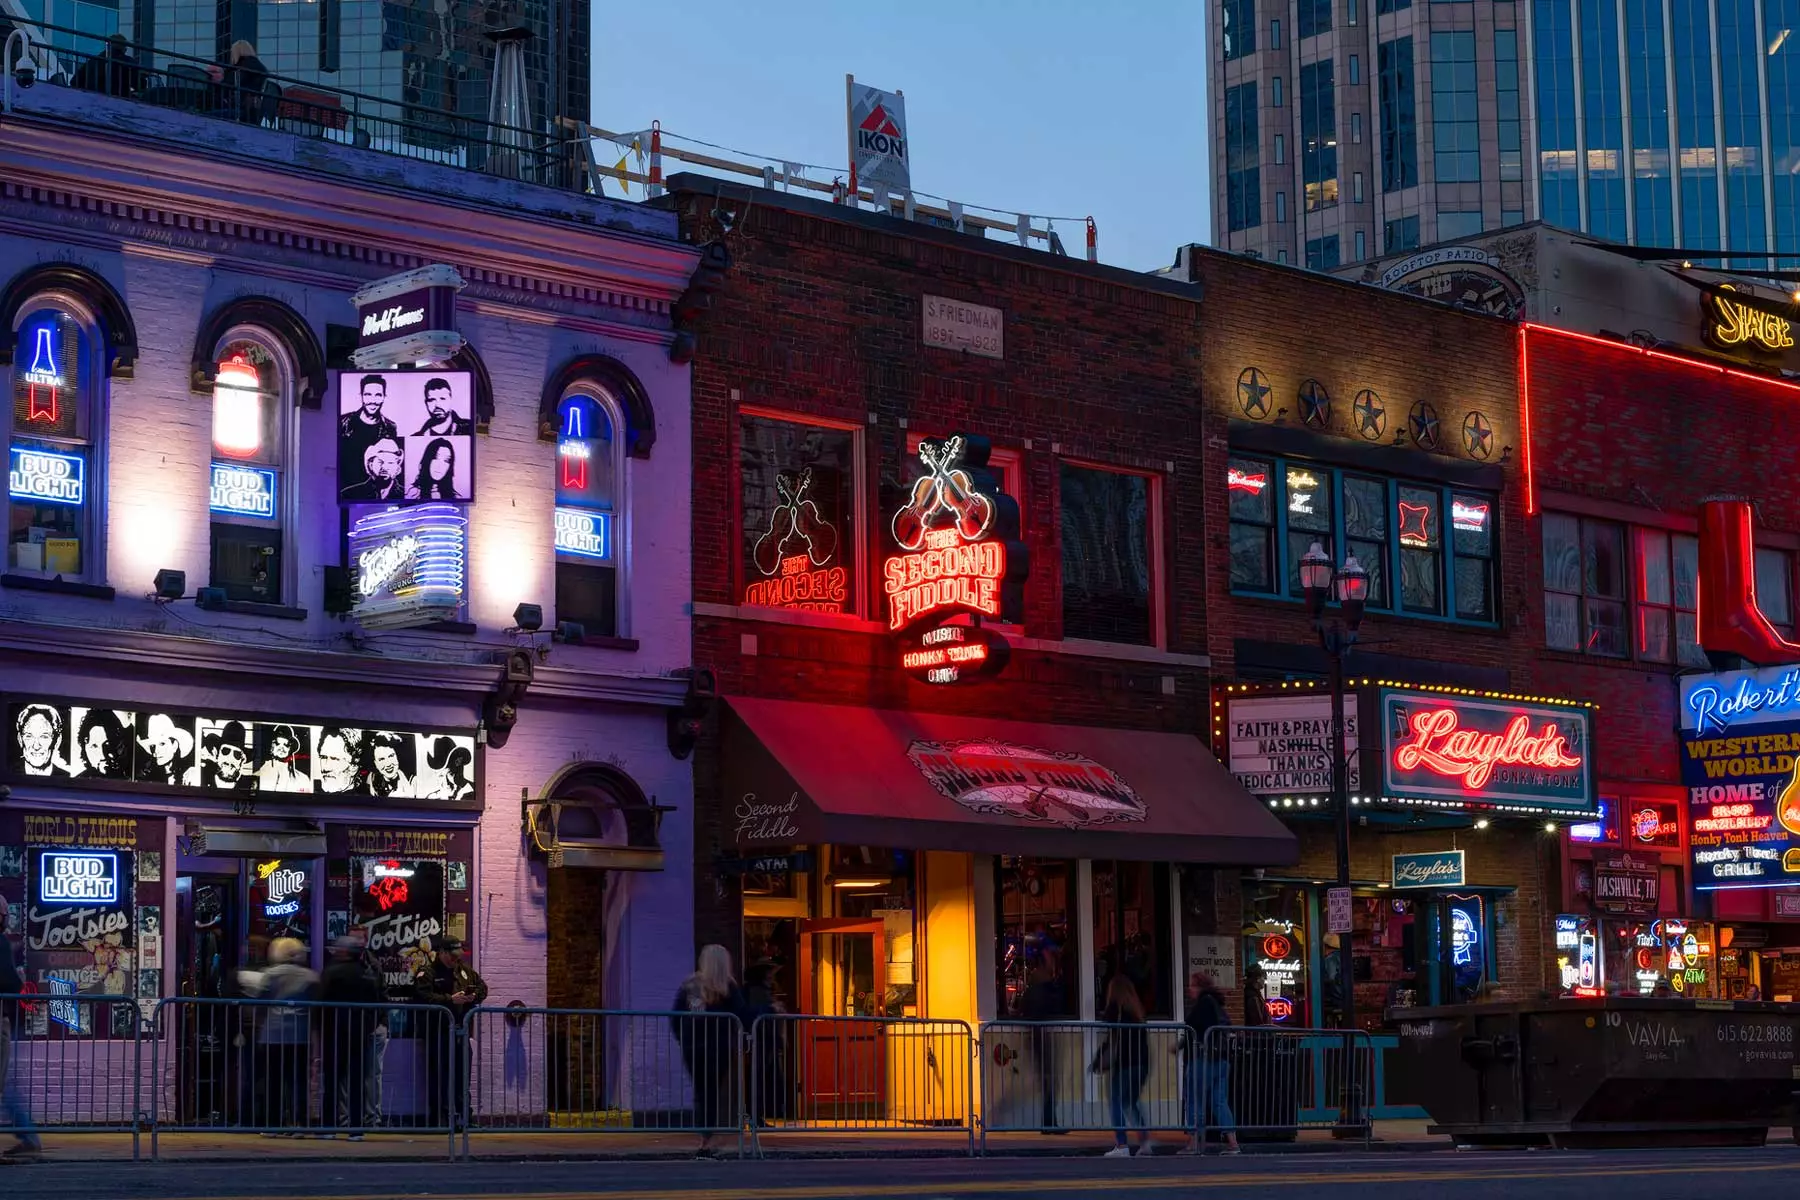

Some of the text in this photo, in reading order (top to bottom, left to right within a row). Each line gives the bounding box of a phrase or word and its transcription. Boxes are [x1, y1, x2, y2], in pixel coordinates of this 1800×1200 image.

[859, 131, 903, 158] IKON
[1385, 250, 1484, 284] ROOFTOP PATIO
[1714, 284, 1794, 348] STAGE
[20, 453, 71, 479] BUD
[214, 468, 262, 493] BUD
[555, 512, 593, 533] BUD
[925, 528, 960, 550] THE
[884, 541, 1005, 594] SECOND
[889, 577, 1000, 630] FIDDLE
[903, 650, 945, 667] HONKY
[1690, 668, 1800, 738] Robert's
[1237, 721, 1279, 737] FAITH
[1293, 719, 1356, 737] PRAYS
[1259, 737, 1334, 754] NASHVILLE
[1394, 709, 1581, 788] Layla's
[1267, 755, 1325, 772] THANKS
[1703, 755, 1794, 778] WORLD
[917, 753, 1028, 799] SECOND
[1291, 773, 1358, 789] WORKS
[1492, 770, 1579, 788] HONKY TONK
[1691, 780, 1783, 804] HOME of
[735, 792, 798, 818] Second
[24, 815, 137, 845] WORLD FAMOUS
[734, 816, 799, 844] Fiddle
[1690, 830, 1789, 847] Honky Tonk Heaven
[348, 830, 447, 855] WORLD FAMOUS
[54, 857, 105, 878] BUD
[755, 858, 788, 870] ATM
[1396, 860, 1460, 883] Layla's
[268, 869, 305, 903] Lite
[1646, 880, 1656, 899] TN
[29, 906, 129, 950] Tootsies
[353, 914, 441, 950] Tootsies
[1257, 958, 1301, 970] Handmade
[1266, 971, 1293, 980] VODKA
[38, 968, 100, 984] LOUNGE
[1684, 968, 1705, 984] ATM
[1604, 1011, 1621, 1027] 10
[1716, 1025, 1793, 1042] 615.622.8888
